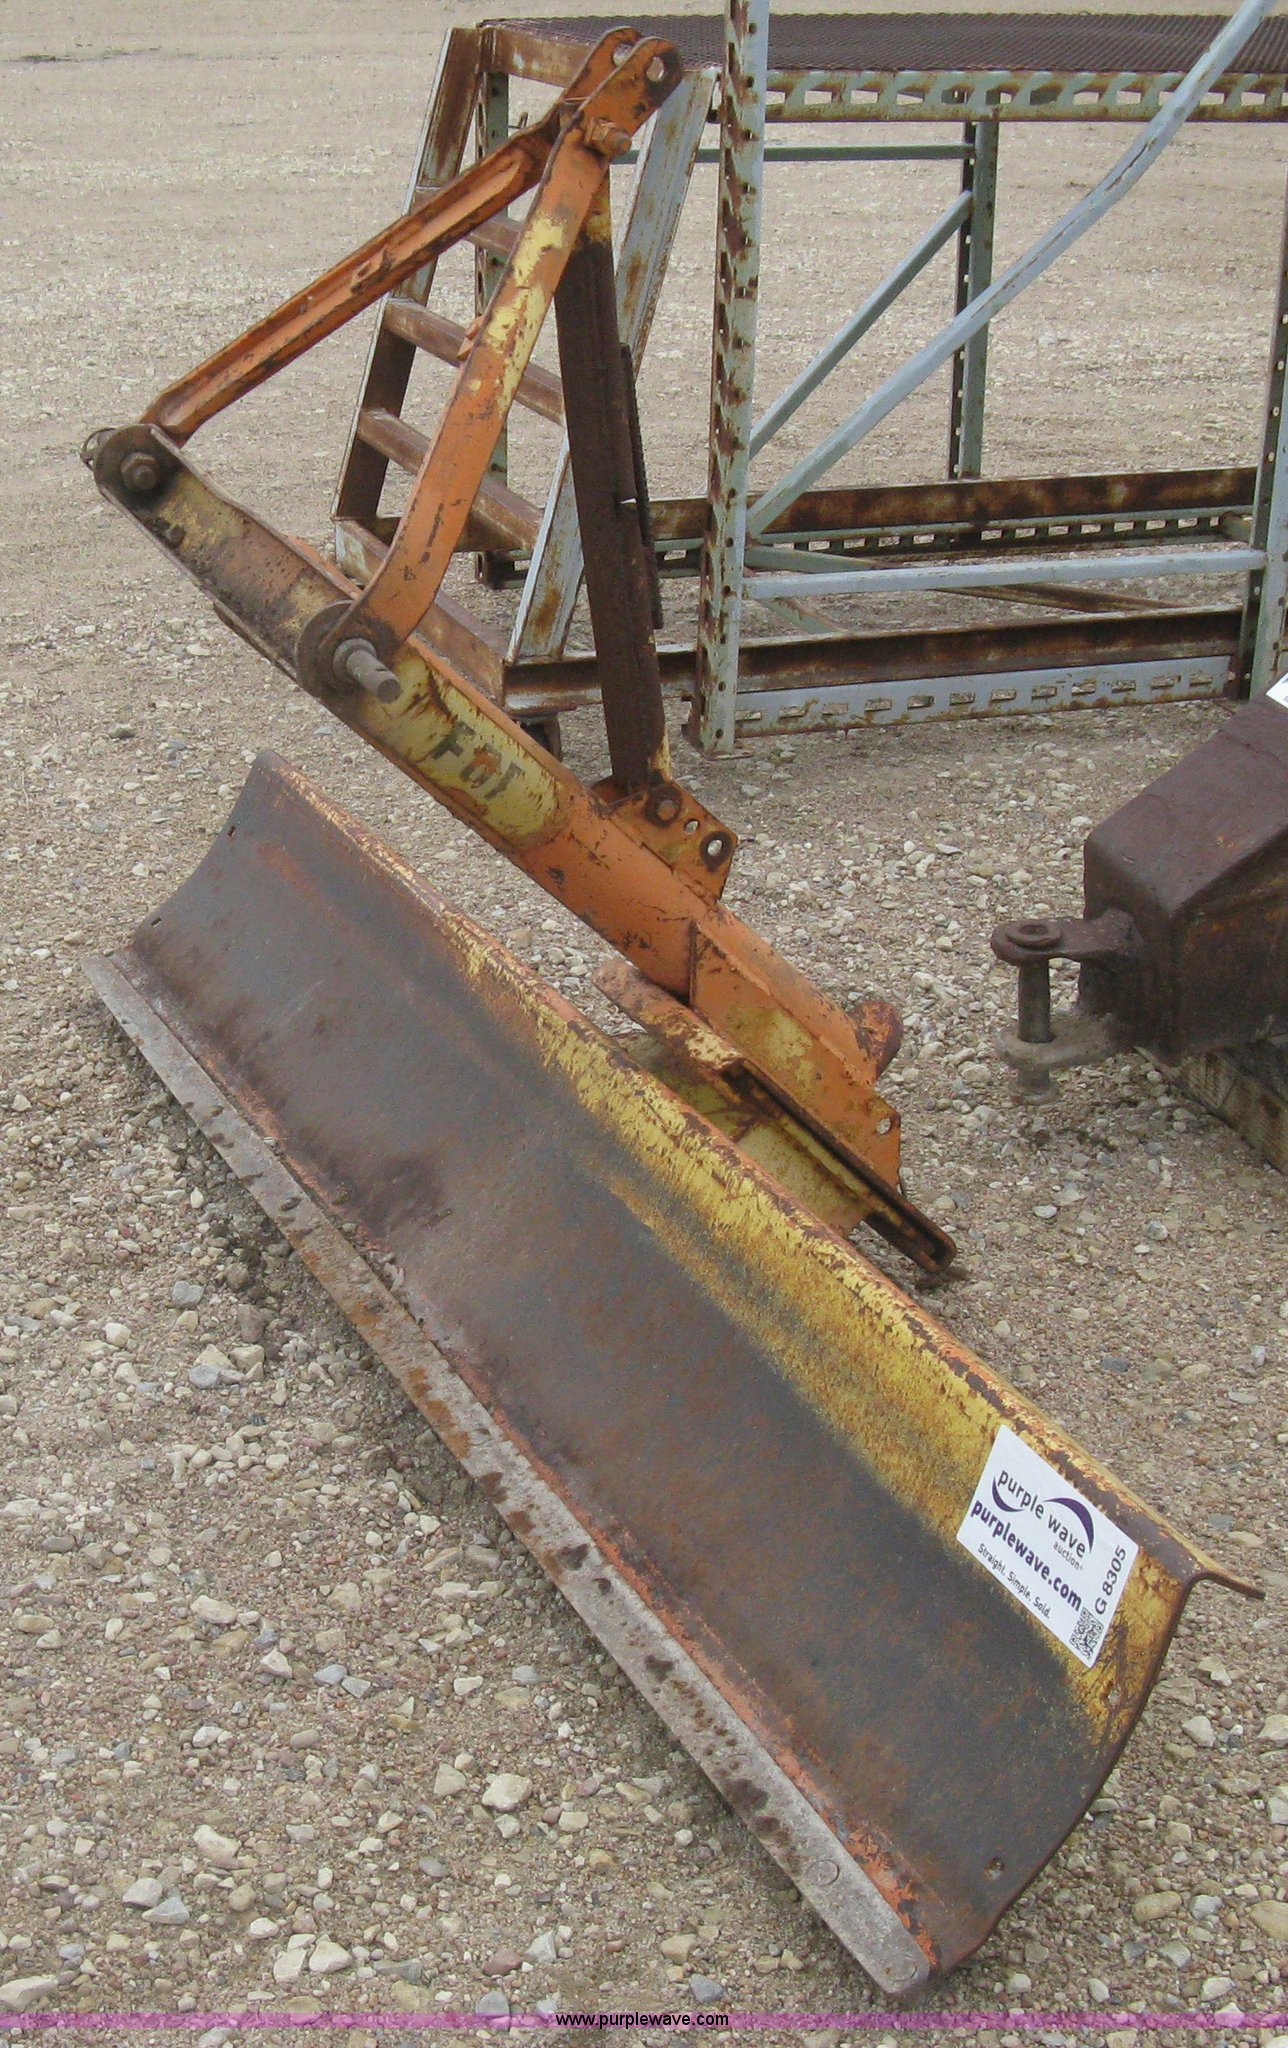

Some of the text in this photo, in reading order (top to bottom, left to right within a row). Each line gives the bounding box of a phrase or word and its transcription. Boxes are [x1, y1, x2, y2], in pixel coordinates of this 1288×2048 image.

[970, 1500, 1083, 1612] purplewave.com
[997, 1470, 1086, 1559] purple wave
[978, 1543, 1052, 1620] Straight. Simple. Sold.
[1094, 1545, 1126, 1615] G 8305
